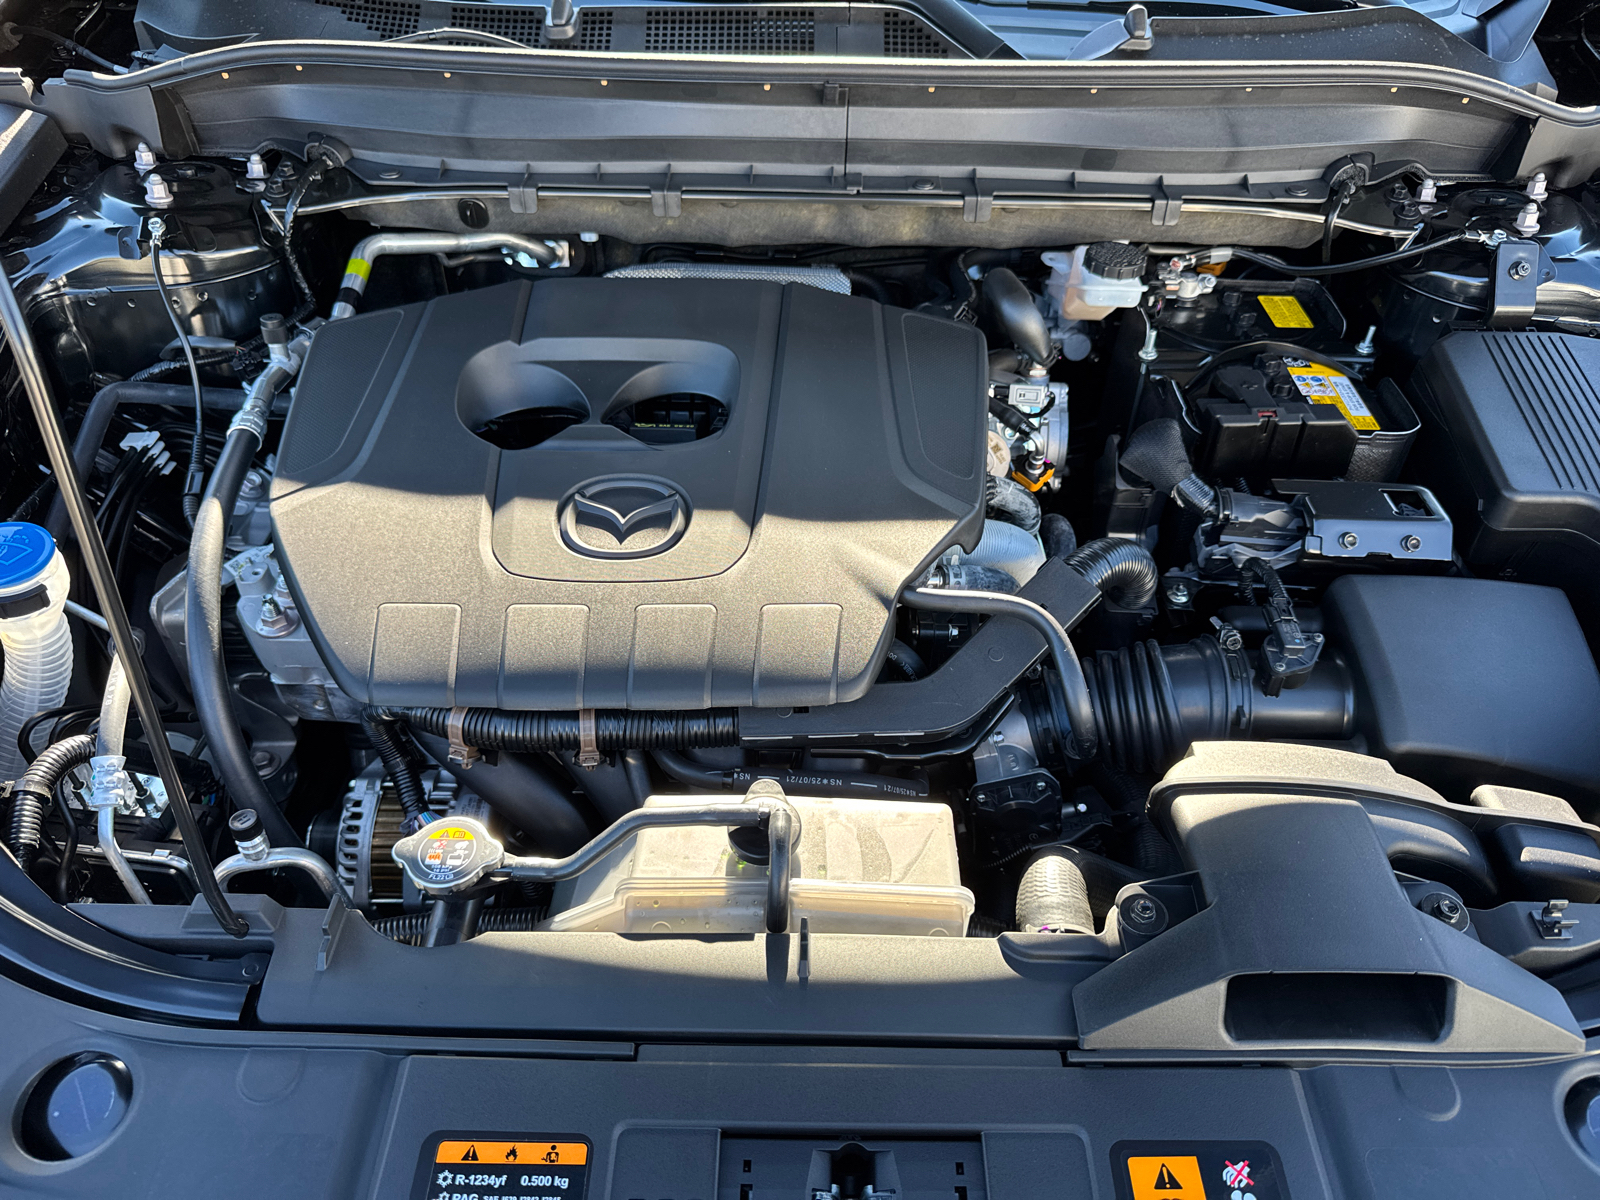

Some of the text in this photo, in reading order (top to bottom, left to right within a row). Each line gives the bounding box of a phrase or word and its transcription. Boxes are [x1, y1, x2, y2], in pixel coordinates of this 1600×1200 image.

[454, 1174, 569, 1190] R-1234yf 0.500 kg
